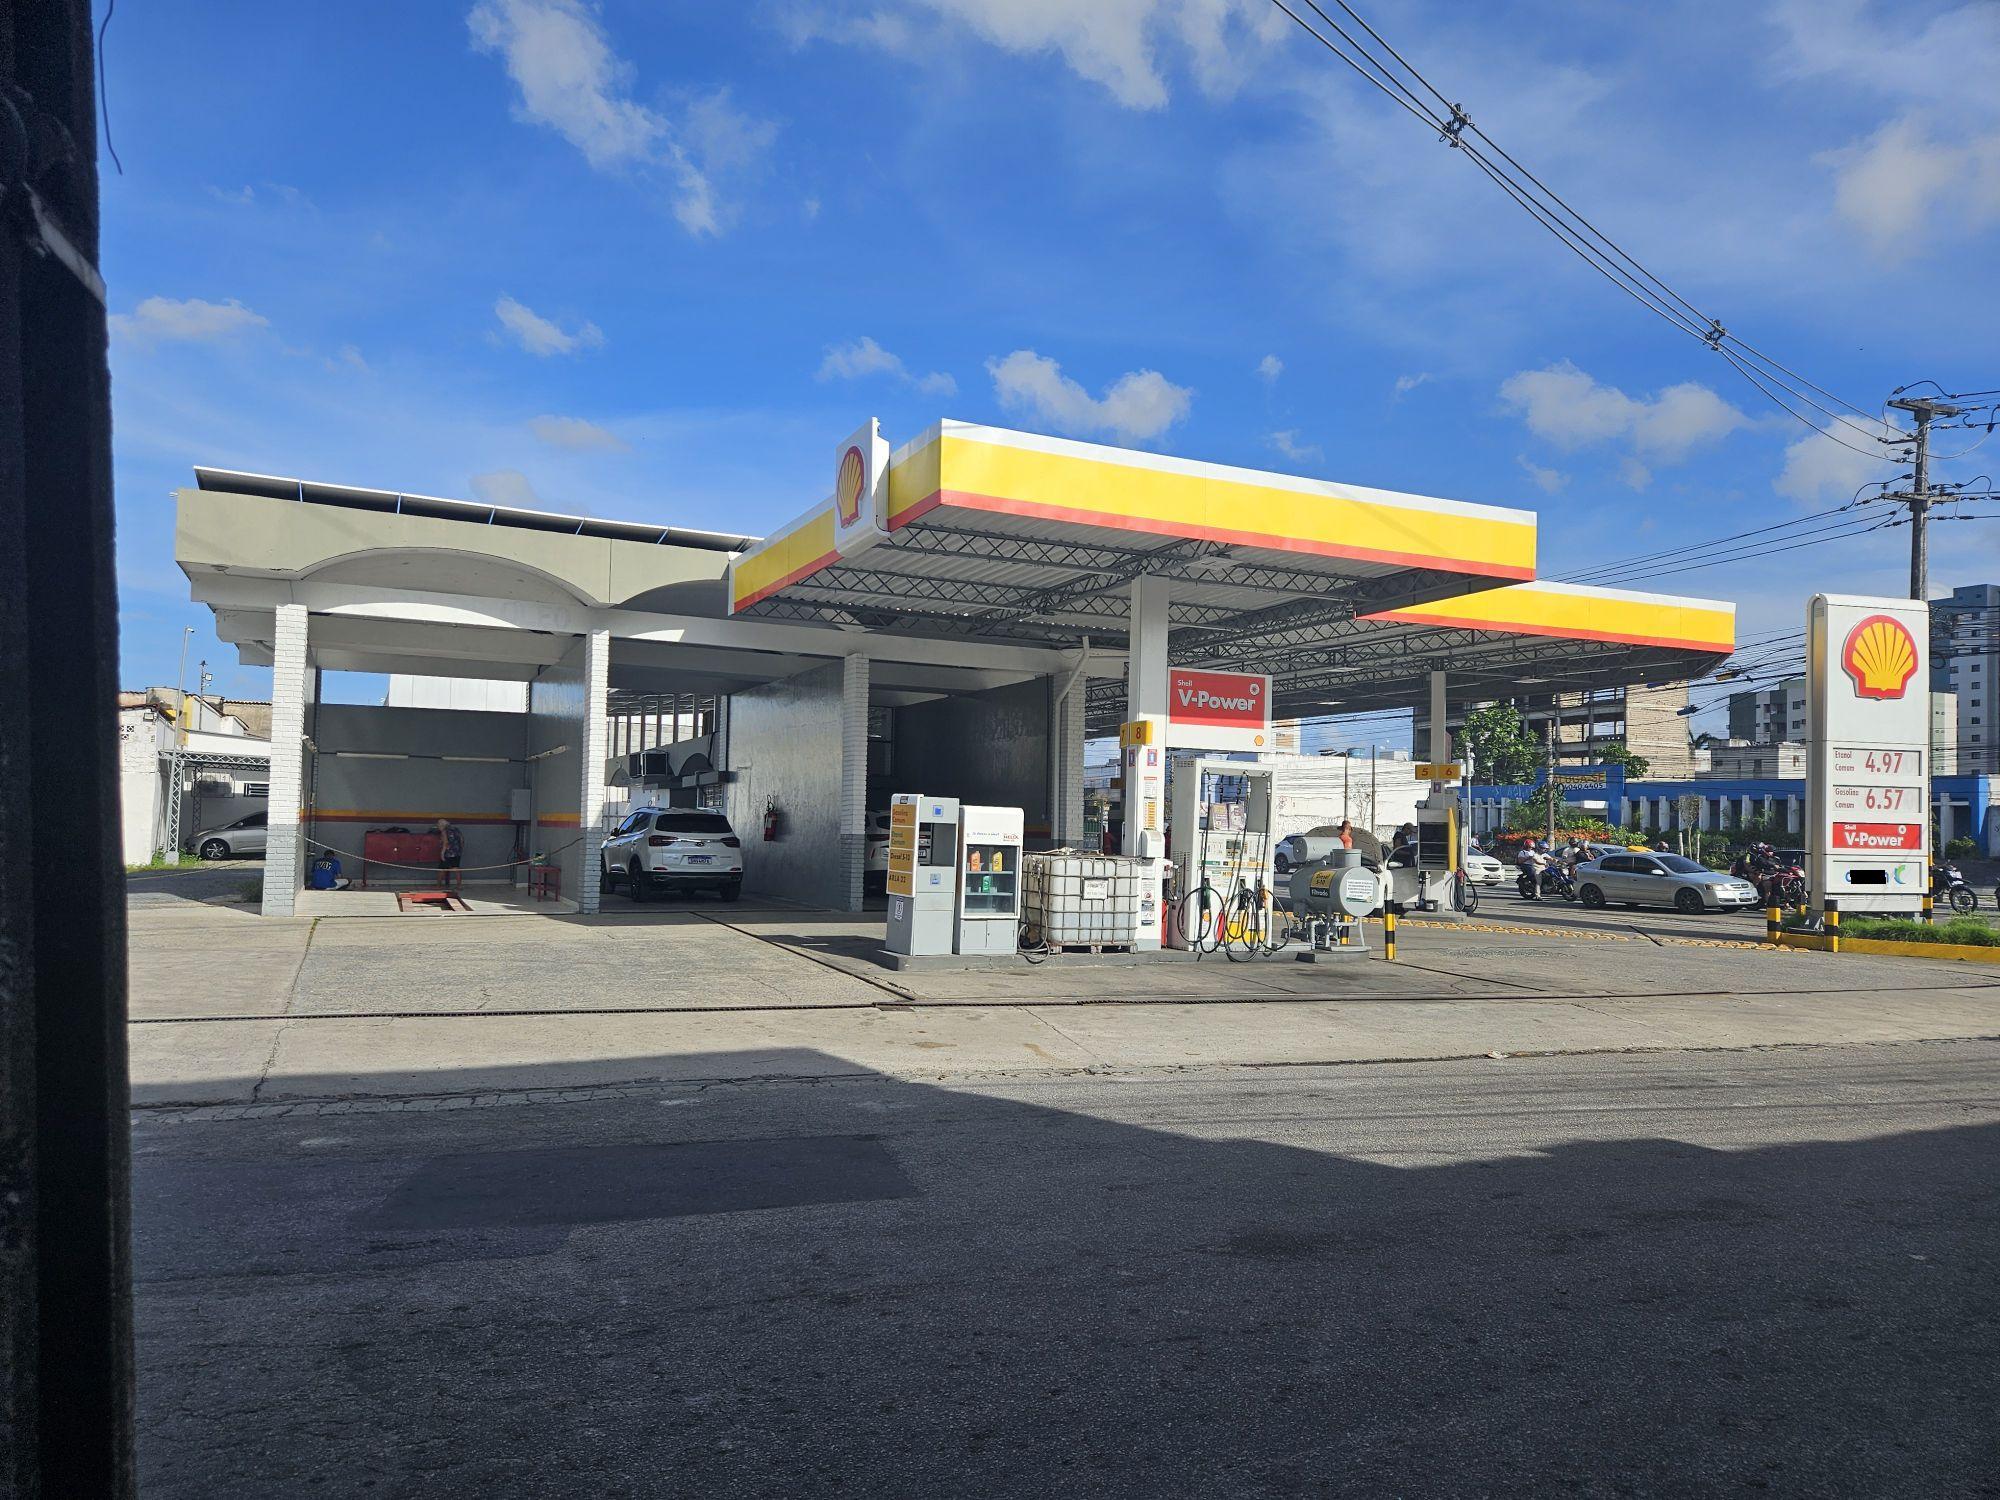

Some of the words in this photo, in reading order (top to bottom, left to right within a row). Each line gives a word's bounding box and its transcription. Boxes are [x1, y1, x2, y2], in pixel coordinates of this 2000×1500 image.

[1178, 689, 1256, 712] V-Power
[1135, 726, 1142, 739] 8
[1835, 751, 1852, 759] Etanol
[1865, 752, 1903, 773] 4.97
[1421, 767, 1429, 777] 5
[1445, 767, 1453, 776] 6
[1835, 764, 1855, 772] Comum
[1835, 788, 1859, 796] Gasolina
[1866, 789, 1904, 810] 6.57
[1835, 801, 1855, 809] Comum
[1844, 832, 1904, 847] V-Power
[1311, 889, 1329, 897] Filtrado
